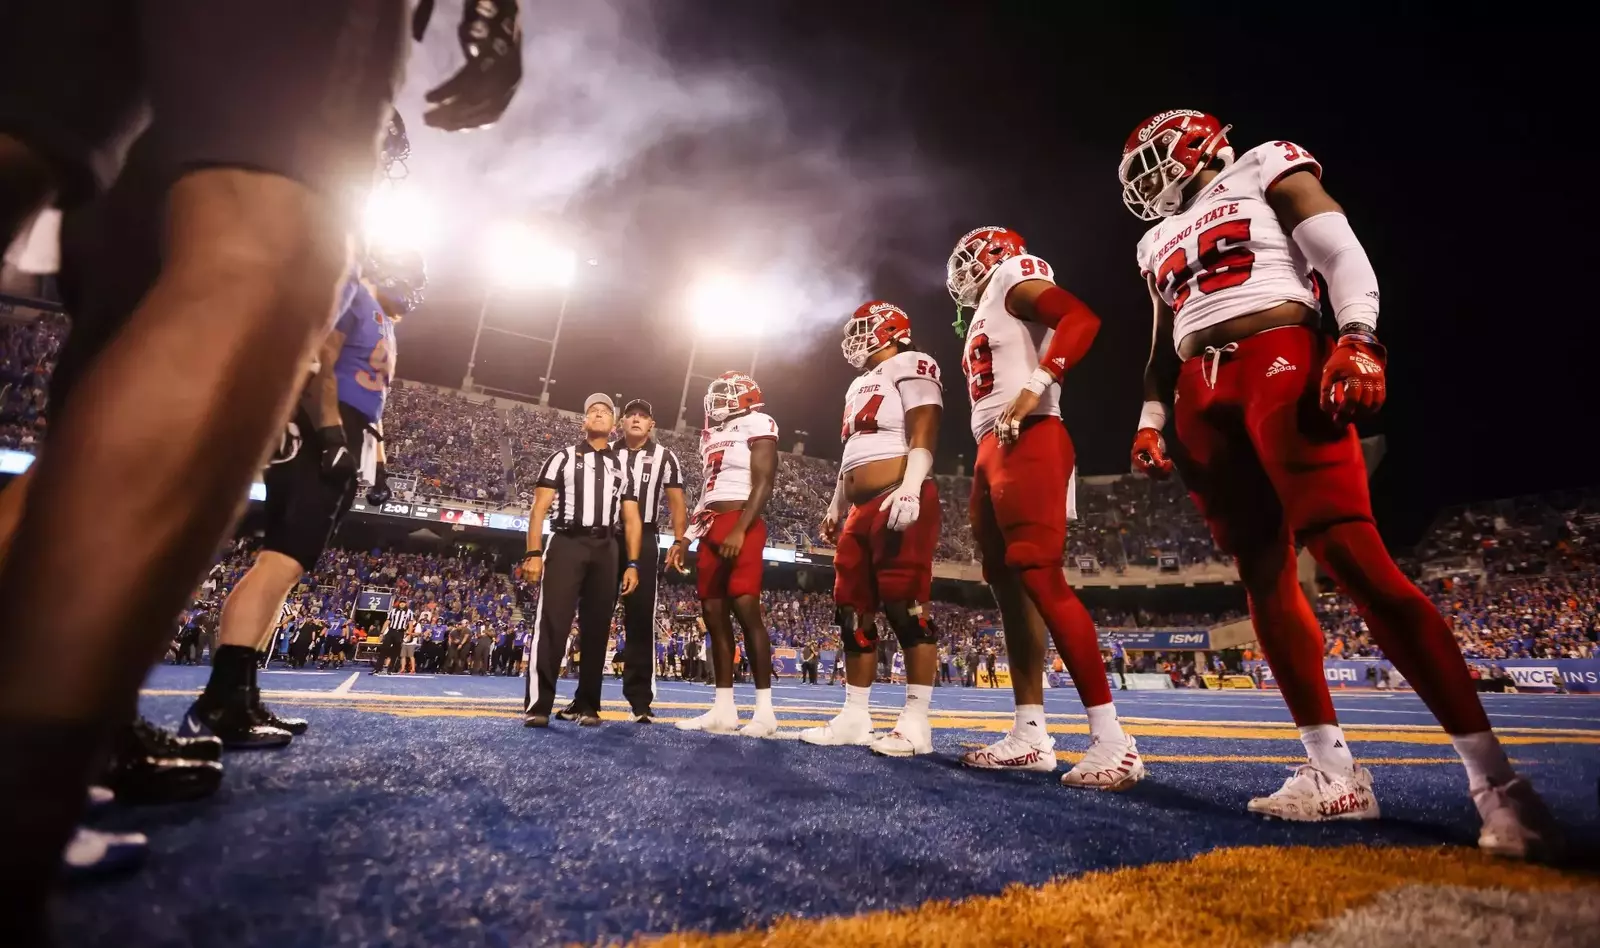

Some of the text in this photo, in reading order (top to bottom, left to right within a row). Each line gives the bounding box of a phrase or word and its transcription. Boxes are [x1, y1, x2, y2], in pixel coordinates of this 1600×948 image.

[1138, 108, 1205, 142] Bulldogs
[1195, 202, 1240, 231] STATE
[1020, 258, 1049, 277] 99
[1155, 217, 1256, 314] 35
[916, 359, 937, 380] 54
[1349, 355, 1382, 371] adidas
[1265, 364, 1297, 378] adidas
[858, 384, 881, 394] STATE
[642, 473, 650, 482] U
[706, 450, 725, 492] 7
[393, 481, 407, 490] 123
[368, 596, 381, 606] 23
[1168, 634, 1204, 644] ISMI
[1511, 670, 1600, 683] WCF INS
